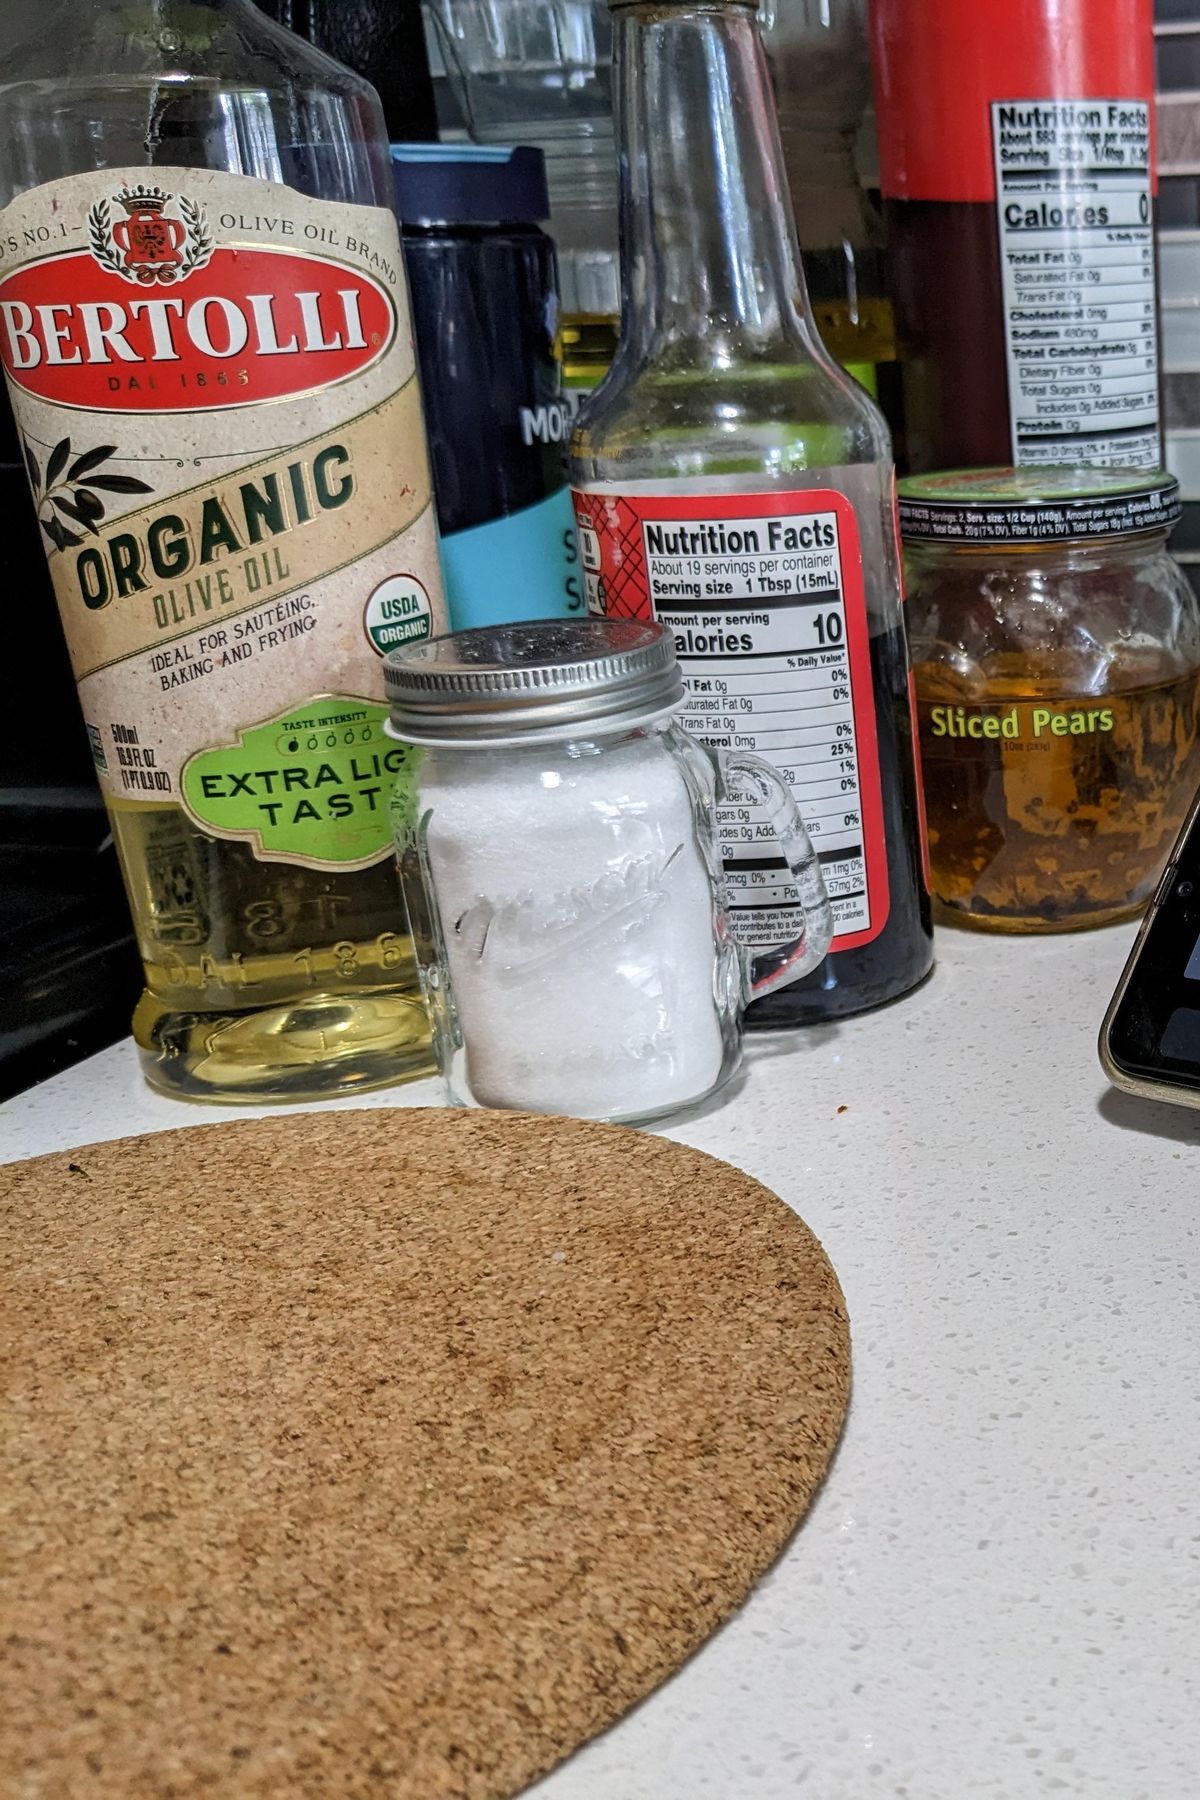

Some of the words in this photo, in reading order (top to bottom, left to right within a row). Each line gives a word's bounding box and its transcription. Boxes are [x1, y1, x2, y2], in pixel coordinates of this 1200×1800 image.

[1000, 106, 1100, 128] Nutrition
[1108, 105, 1147, 128] Facts
[1001, 148, 1049, 165] Serving
[1005, 202, 1109, 228] Calores
[1139, 193, 1148, 224] 0
[220, 213, 294, 235] OLIVE
[304, 224, 339, 246] OIL
[346, 236, 397, 285] BRAND
[1007, 253, 1039, 264] Total
[1044, 252, 1064, 263] Fat
[1014, 272, 1066, 285] Saturated
[1017, 291, 1046, 303] Trans
[1010, 309, 1083, 320] Cholesterol
[5, 289, 368, 369] BERTOLLI
[1011, 329, 1059, 340] Sodium
[1012, 348, 1044, 359] Total
[1020, 367, 1058, 379] Dietary
[1021, 385, 1046, 397] Total
[1049, 384, 1085, 397] Sugars
[1017, 421, 1062, 432] Protein
[966, 513, 985, 523] Serv.
[987, 513, 1005, 523] size:
[1006, 512, 1019, 524] 1/2
[1020, 512, 1036, 524] Cup
[1066, 509, 1092, 521] Amount
[1093, 509, 1103, 520] per
[76, 444, 357, 610] ORGANIC
[1072, 522, 1087, 533] Total
[1088, 519, 1109, 532] Sugars
[646, 524, 760, 556] Nutrition
[768, 519, 835, 551] Facts
[651, 560, 683, 576] About
[687, 560, 701, 575] 19
[705, 559, 756, 578] servings
[760, 559, 779, 576] per
[783, 553, 833, 571] container
[153, 568, 234, 629] OLIVE
[245, 546, 291, 592] OIL
[653, 579, 701, 597] Serving
[705, 579, 733, 595] size
[746, 578, 753, 593] 1
[758, 577, 791, 594] Tbsp
[796, 570, 839, 593] (15mL)
[381, 594, 420, 619] USDA
[657, 614, 699, 626] Amount
[703, 615, 721, 629] per
[725, 612, 770, 626] serving
[379, 619, 428, 645] ORGANIC
[675, 629, 754, 653] alories
[813, 612, 842, 645] 10
[151, 645, 194, 673] IDEAL
[199, 631, 228, 653] FOR
[160, 658, 214, 691] BAKING
[222, 642, 253, 668] AND
[798, 656, 818, 668] Daily
[694, 680, 712, 692] Fat
[715, 680, 727, 694] 0g
[831, 668, 847, 682] 0%
[722, 698, 738, 711] Fat
[740, 698, 752, 712] 0g
[833, 687, 849, 701] 0%
[282, 719, 316, 731] TASTE
[318, 711, 368, 727] INTENSITY
[679, 716, 704, 729] Trans
[707, 716, 721, 729] Fat
[723, 716, 736, 731] 0g
[931, 706, 1020, 738] Sliced
[1032, 708, 1115, 738] Pears
[111, 723, 139, 744] 500ml
[735, 735, 755, 749] 0mg
[836, 724, 852, 737] 0%
[143, 749, 157, 767] OZ
[831, 743, 853, 756] 25%
[201, 763, 343, 798] EXTRA
[351, 747, 412, 781] LIG
[782, 769, 795, 783] 2g
[839, 760, 855, 773] 1%
[841, 778, 856, 791] 0%
[259, 787, 384, 827] TAST
[738, 809, 750, 823] 0g
[741, 827, 753, 841] 0g
[844, 813, 860, 826] 0%
[721, 844, 733, 858] 0g
[833, 863, 849, 875] 1mg
[850, 861, 863, 871] 0%
[751, 872, 766, 884] 0%
[829, 881, 851, 893] 57mg
[852, 875, 864, 887] 2%
[731, 911, 751, 920] Value
[751, 911, 765, 920] tells
[767, 911, 779, 921] you
[781, 910, 795, 919] how
[842, 909, 864, 920] calories
[740, 921, 776, 931] contributes
[777, 921, 784, 929] to
[747, 931, 772, 943] general
